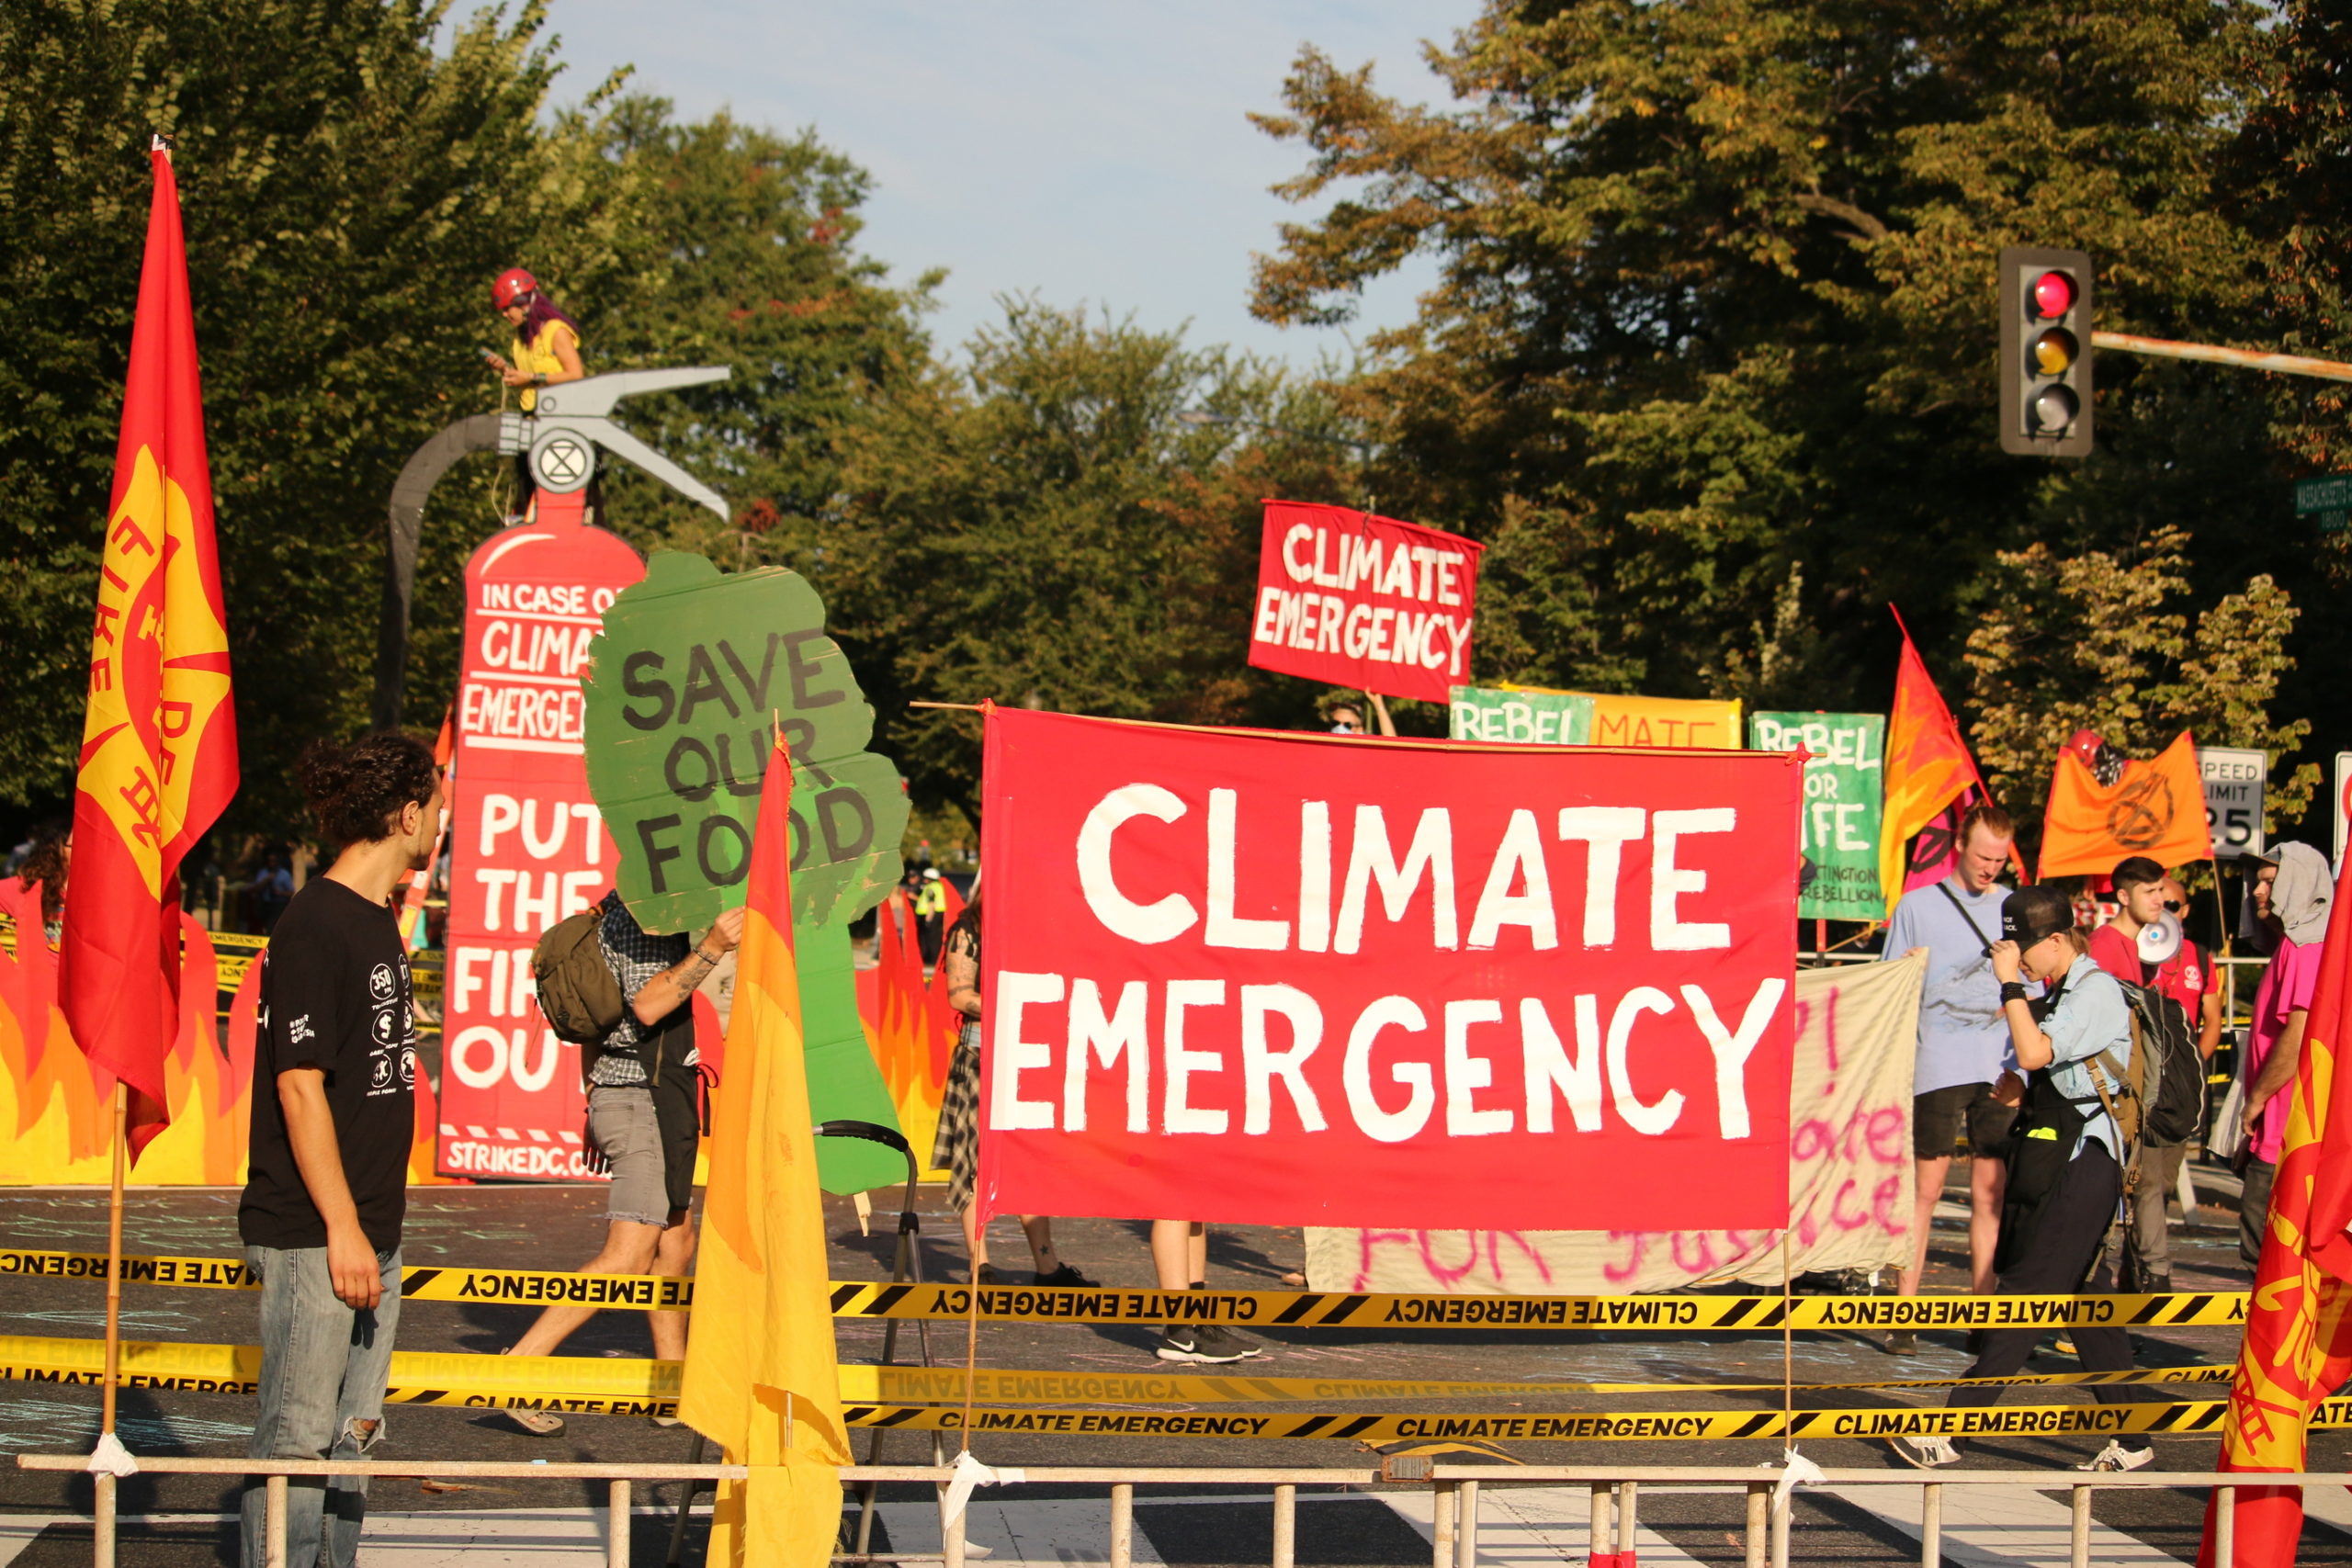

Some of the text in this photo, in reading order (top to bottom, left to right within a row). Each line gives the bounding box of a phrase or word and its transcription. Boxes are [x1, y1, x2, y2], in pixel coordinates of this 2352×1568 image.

[1283, 523, 1464, 606] CLIMATE
[482, 584, 625, 615] IN CASE O
[481, 620, 605, 676] CLIMA
[1254, 586, 1473, 676] EMERGENCY
[622, 627, 845, 731] SAVE
[460, 684, 587, 741] EMERGE
[1451, 701, 1577, 745] REBEL
[664, 717, 835, 802] OUR
[1755, 719, 1881, 771] REBEL
[1804, 773, 1838, 799] OR
[2199, 762, 2256, 780] PEED
[2205, 784, 2249, 801] IMIT
[480, 794, 603, 865] PUT
[636, 787, 874, 895] FOOD
[1802, 802, 1870, 852] IFE
[1077, 783, 1736, 954] CLIMATE
[1815, 865, 1878, 885] TINCTION
[475, 868, 604, 933] THE
[1802, 885, 1881, 903] REBELLION
[372, 969, 392, 990] 350
[454, 946, 548, 1019] FIR
[450, 1025, 585, 1093] OU
[989, 970, 1787, 1142] EMERGENCY
[447, 1141, 613, 1180] STRIKEDC.O
[0, 1253, 264, 1286] MATE EMERGENC
[458, 1273, 655, 1304] EMERGENCY
[930, 1289, 1258, 1320] CLIMATE EMERGENCY
[1384, 1298, 1698, 1324] CLIMATE EMERGENCY
[1818, 1299, 2114, 1325] CLIMATE EMERGENCY
[130, 1376, 258, 1395] EMERGE
[2163, 1369, 2235, 1382] CLIM
[938, 1412, 1271, 1436] CLIMATE EMERGENCY
[1396, 1416, 1714, 1438] CLIMATE EMERGENCY
[1832, 1409, 2132, 1435] CLIMATE EMERGENCY
